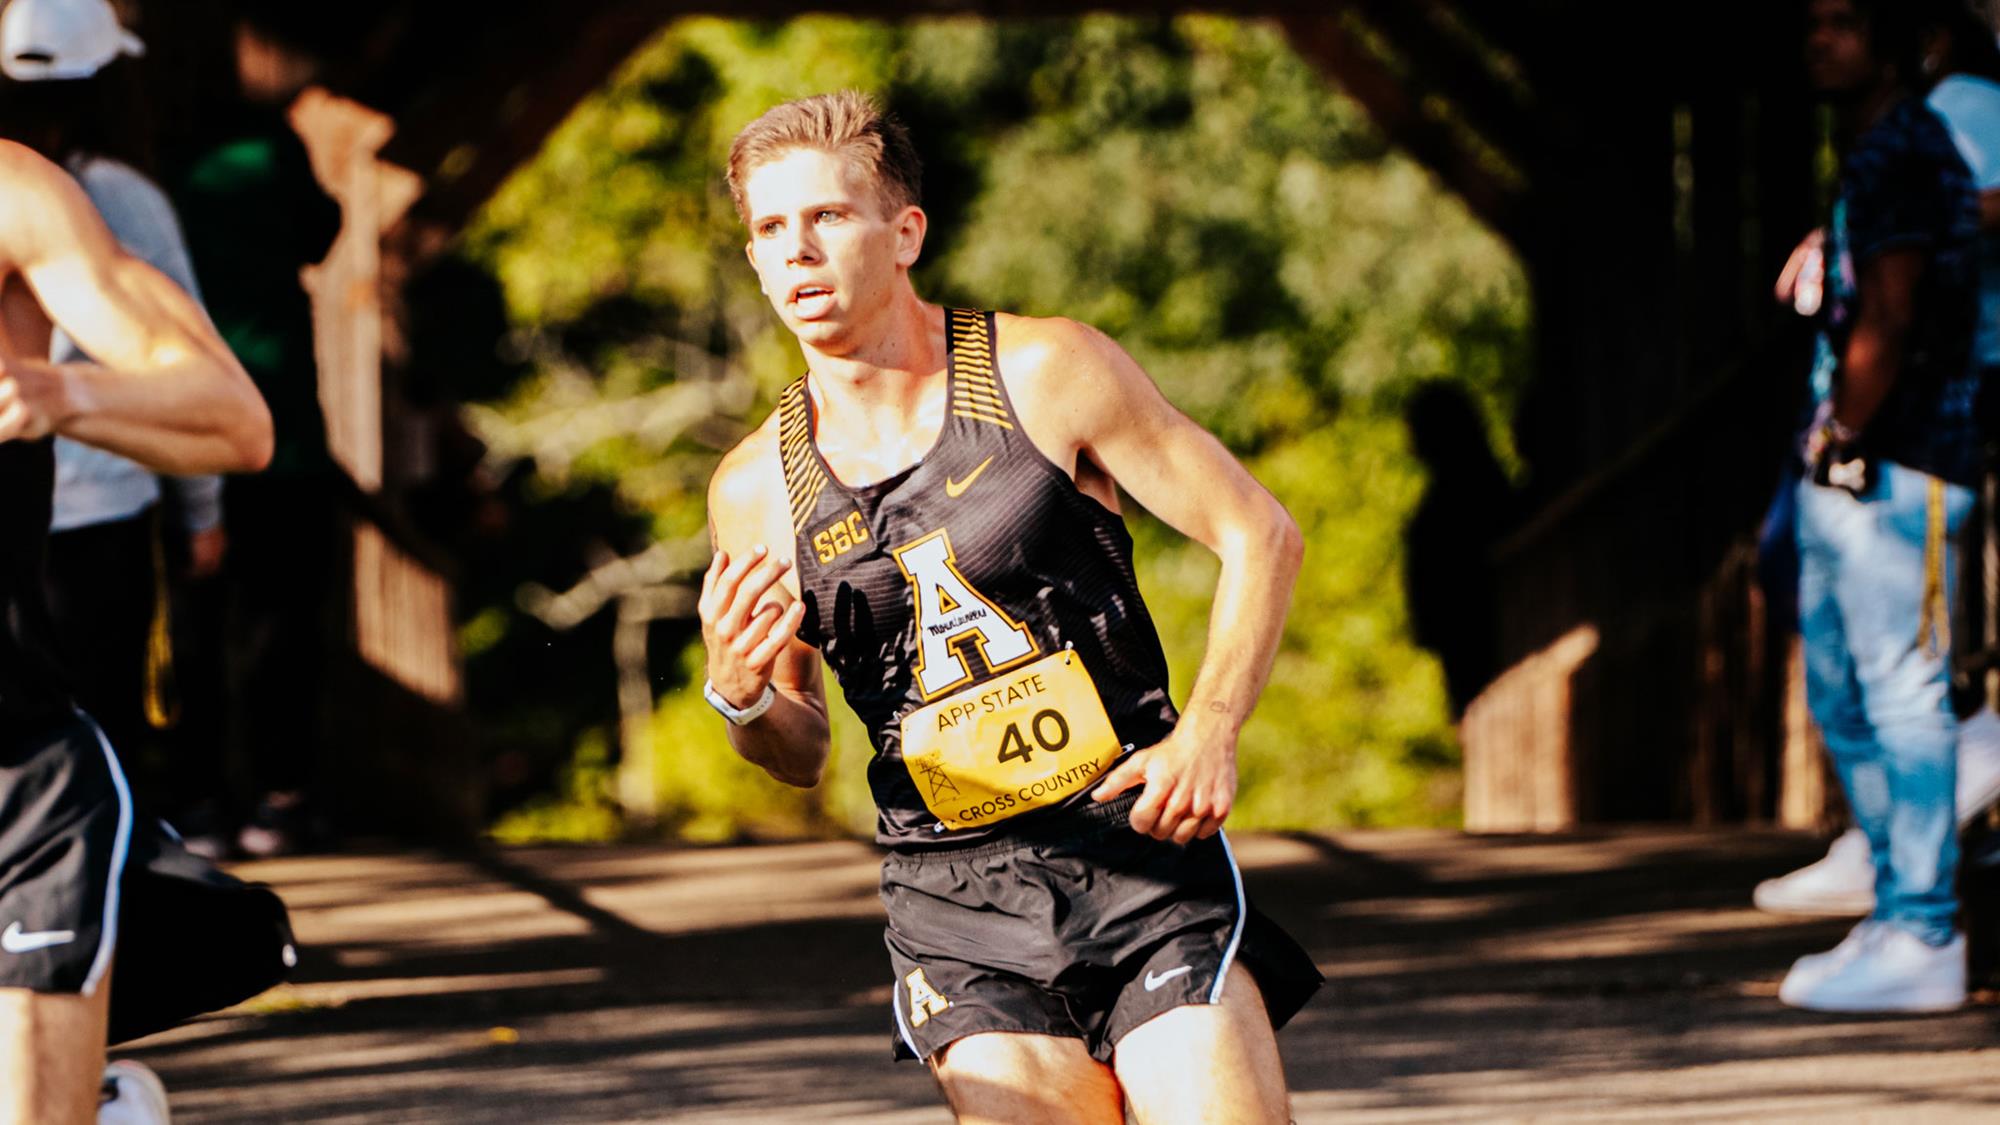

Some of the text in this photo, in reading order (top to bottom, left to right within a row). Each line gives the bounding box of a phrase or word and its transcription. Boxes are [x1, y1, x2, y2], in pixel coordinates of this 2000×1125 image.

[813, 511, 869, 565] SBC
[892, 527, 1040, 701] A
[938, 674, 1047, 732] APP STATE
[997, 708, 1070, 764] 40
[959, 758, 1101, 822] CROSS COUNTRY
[905, 967, 948, 1028] A
